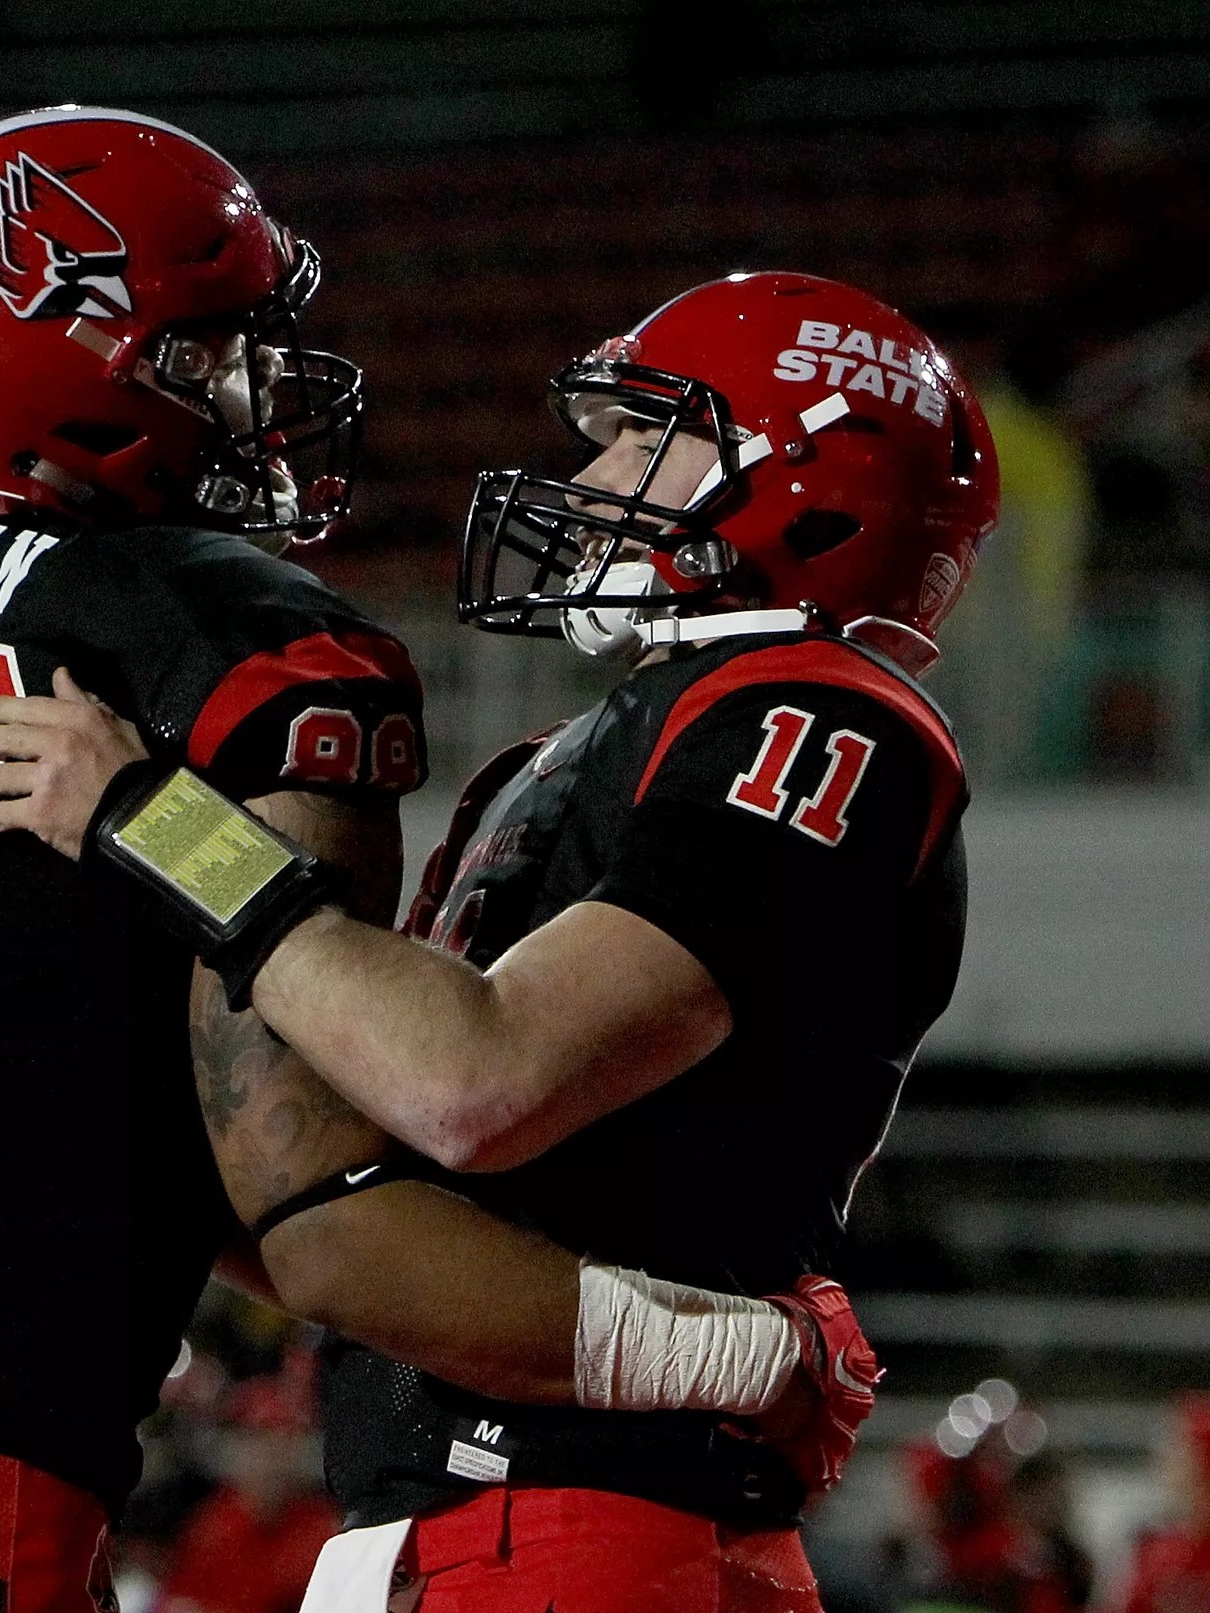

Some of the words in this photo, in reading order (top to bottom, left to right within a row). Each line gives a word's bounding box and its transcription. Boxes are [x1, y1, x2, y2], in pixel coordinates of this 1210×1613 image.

[773, 349, 947, 428] STATE
[278, 706, 422, 790] 88
[726, 705, 877, 847] 11
[473, 1419, 504, 1445] M
